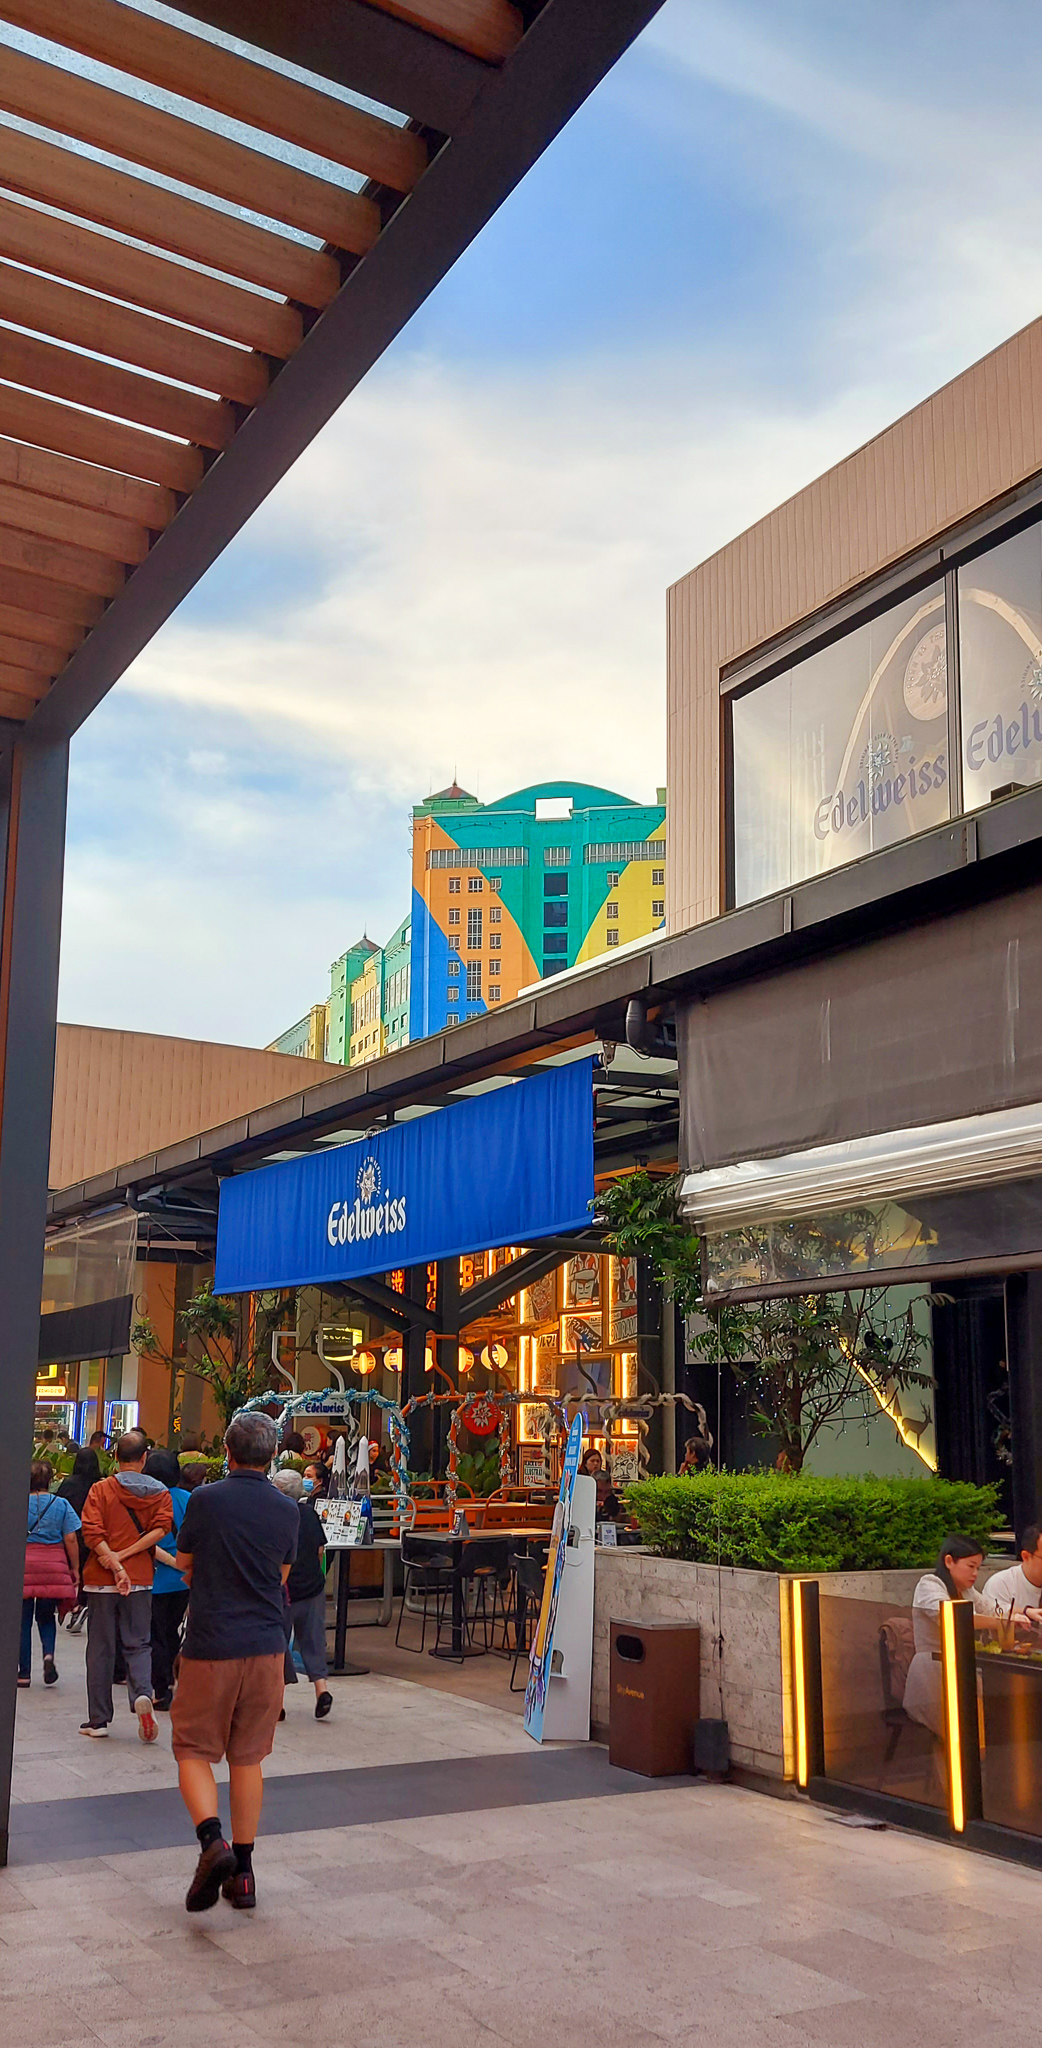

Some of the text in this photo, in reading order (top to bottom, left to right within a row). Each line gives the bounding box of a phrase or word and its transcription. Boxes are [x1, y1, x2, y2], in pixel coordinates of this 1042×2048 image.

[813, 754, 948, 841] Edelweiss
[327, 1188, 407, 1247] Edelweiss
[305, 1401, 345, 1414] Edelweiss
